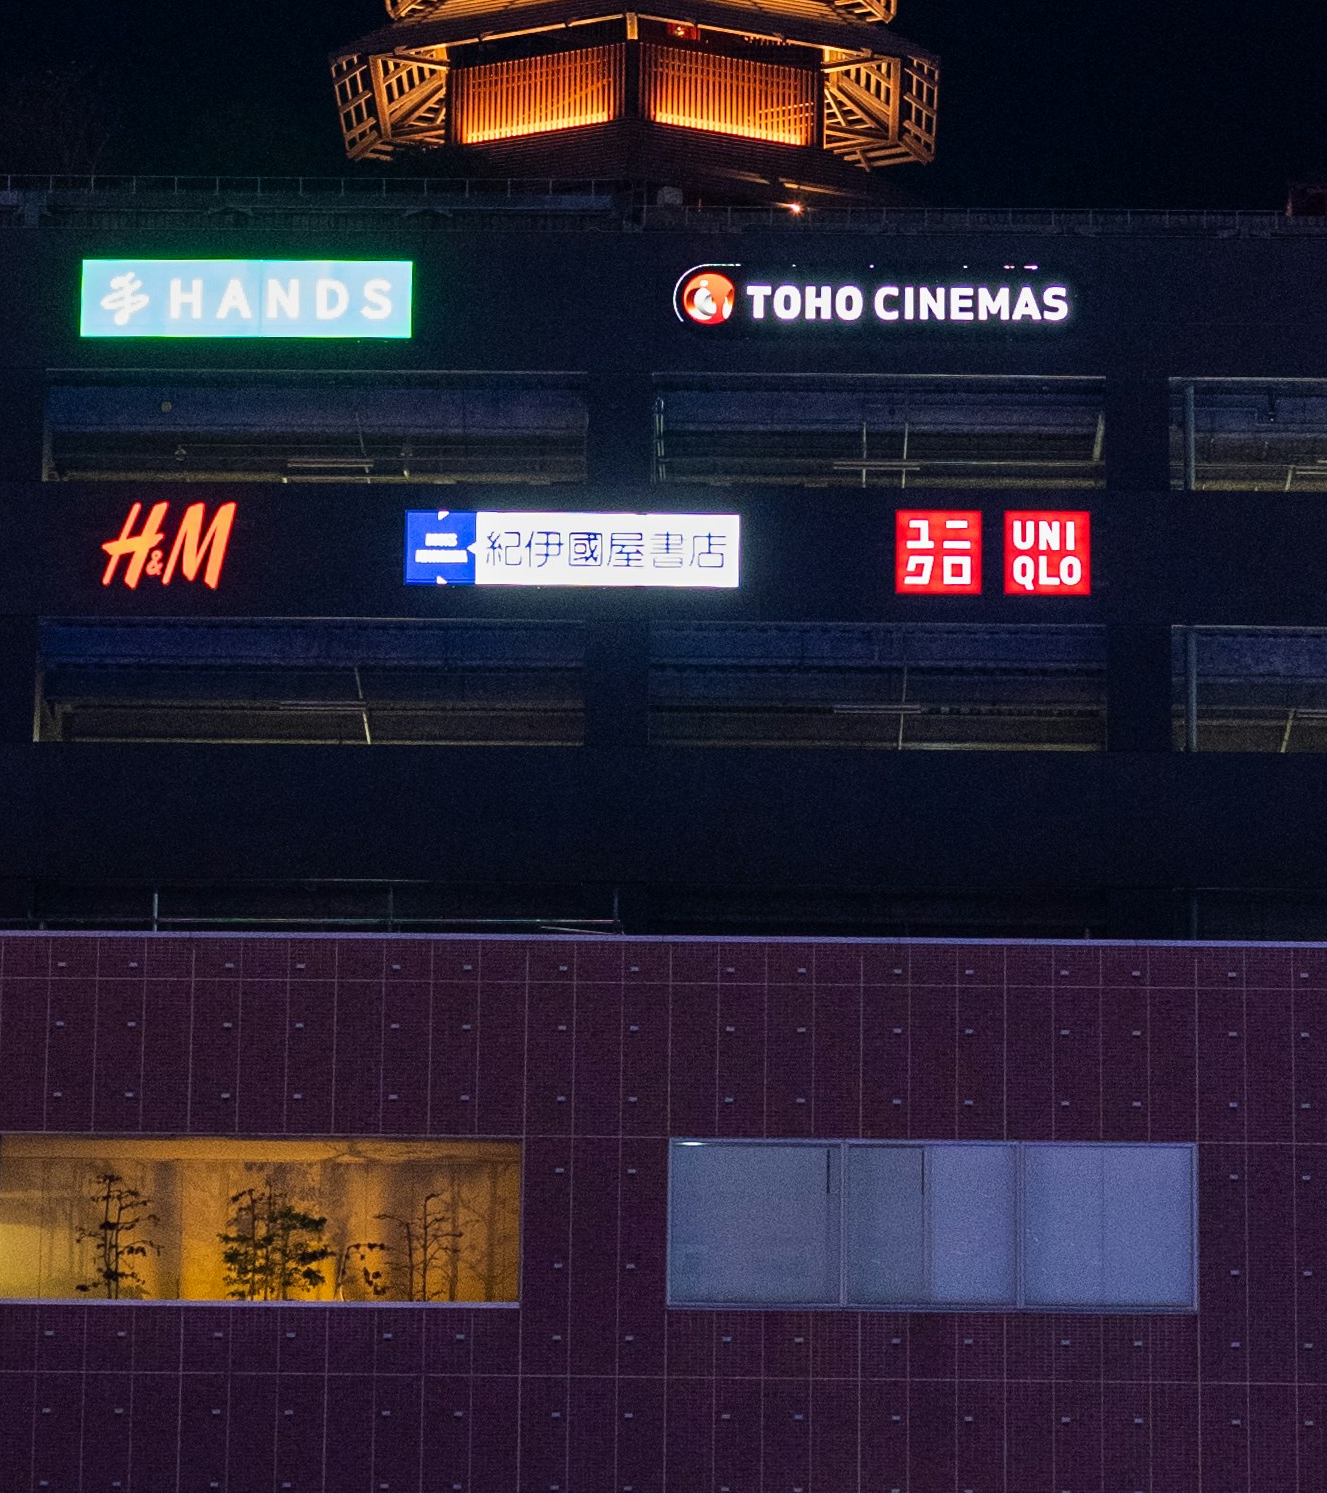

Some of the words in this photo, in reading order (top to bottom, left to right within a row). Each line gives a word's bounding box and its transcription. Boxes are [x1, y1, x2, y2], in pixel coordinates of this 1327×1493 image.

[169, 278, 393, 321] HANDS
[746, 284, 864, 322] TOHO
[873, 285, 1069, 322] CINEMAS
[101, 502, 237, 591] H&M
[485, 530, 727, 569] 紀伊國屋書店
[906, 519, 972, 550] ユニ
[1012, 519, 1076, 551] UNI
[903, 554, 972, 586] クロ
[1012, 554, 1083, 591] QLO
